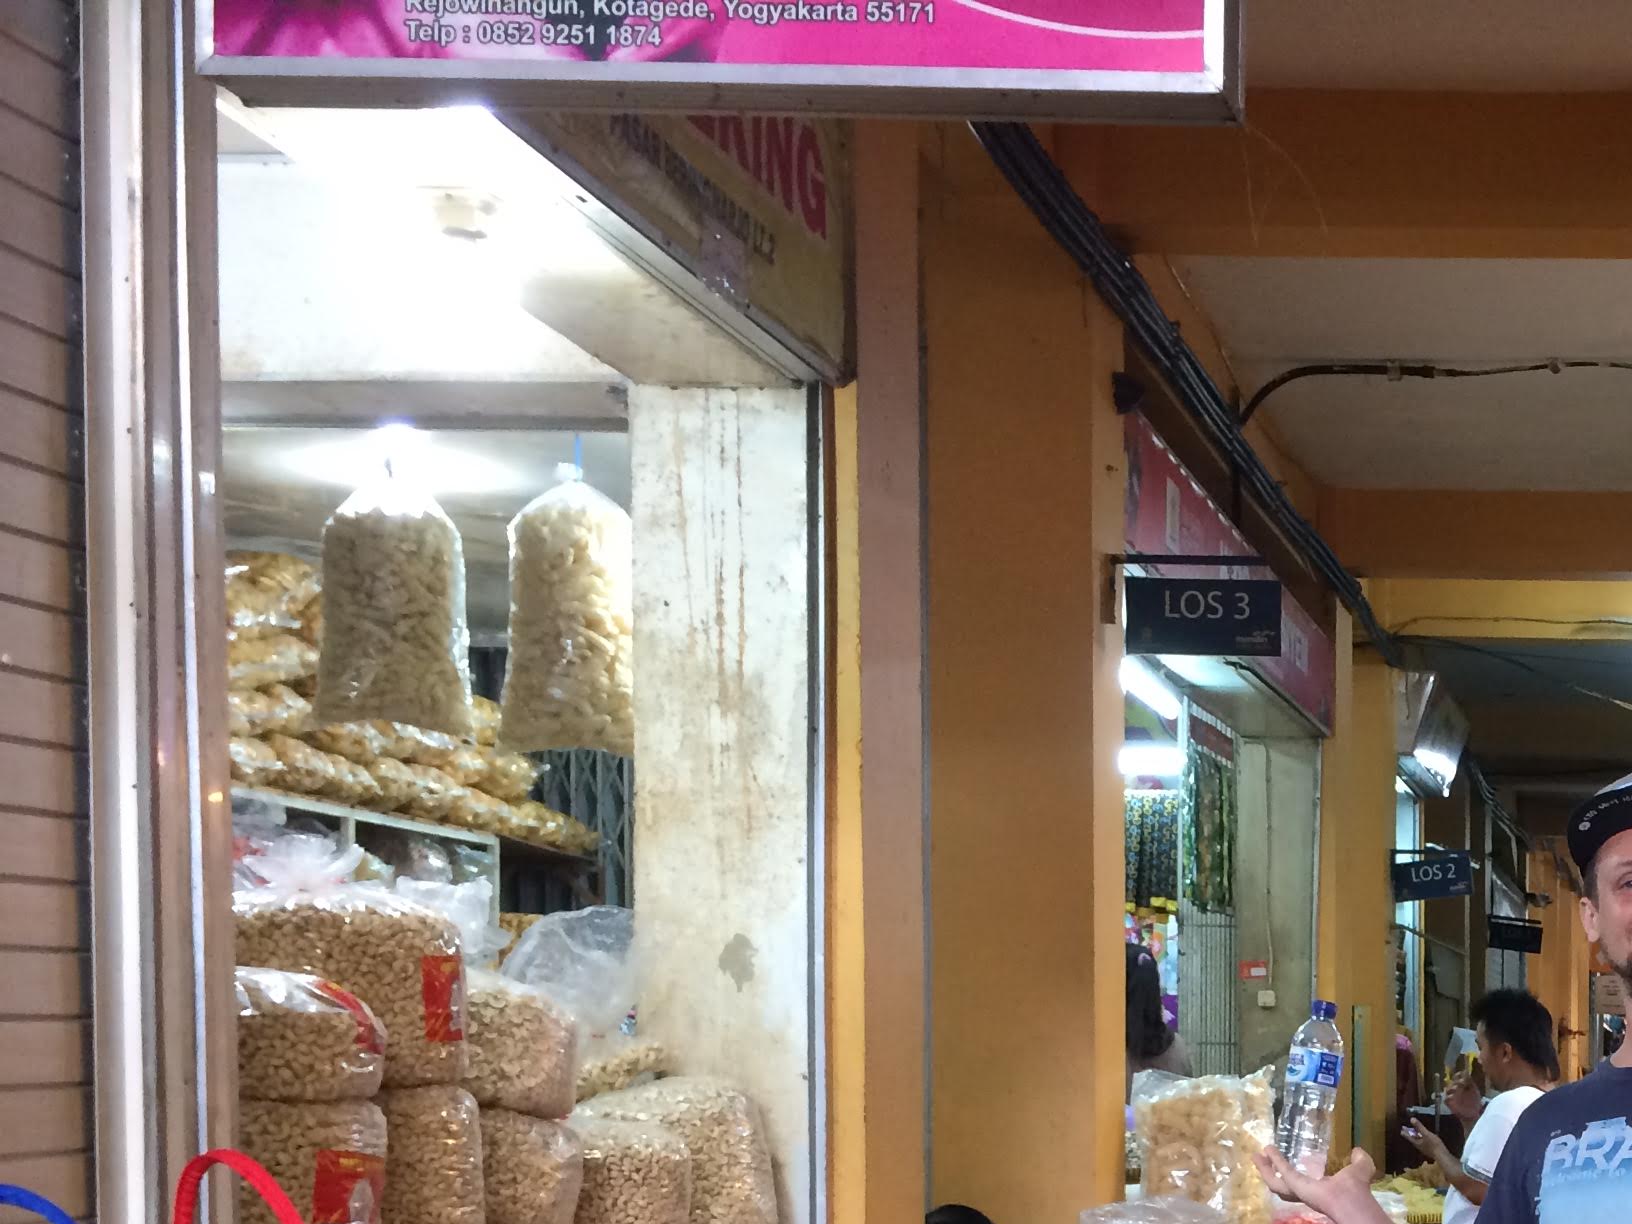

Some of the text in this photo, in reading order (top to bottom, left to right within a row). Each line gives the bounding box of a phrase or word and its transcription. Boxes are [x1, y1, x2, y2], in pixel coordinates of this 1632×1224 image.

[594, 0, 715, 21] Kotagede,
[724, 0, 858, 24] Yogyakarta
[866, 2, 935, 24] 55171
[405, 20, 456, 46] Telp
[478, 22, 534, 45] 0852
[541, 24, 596, 46] 9251
[607, 26, 662, 46] 1874
[1164, 589, 1251, 620] LOS 3
[1411, 863, 1457, 882] LOS 2
